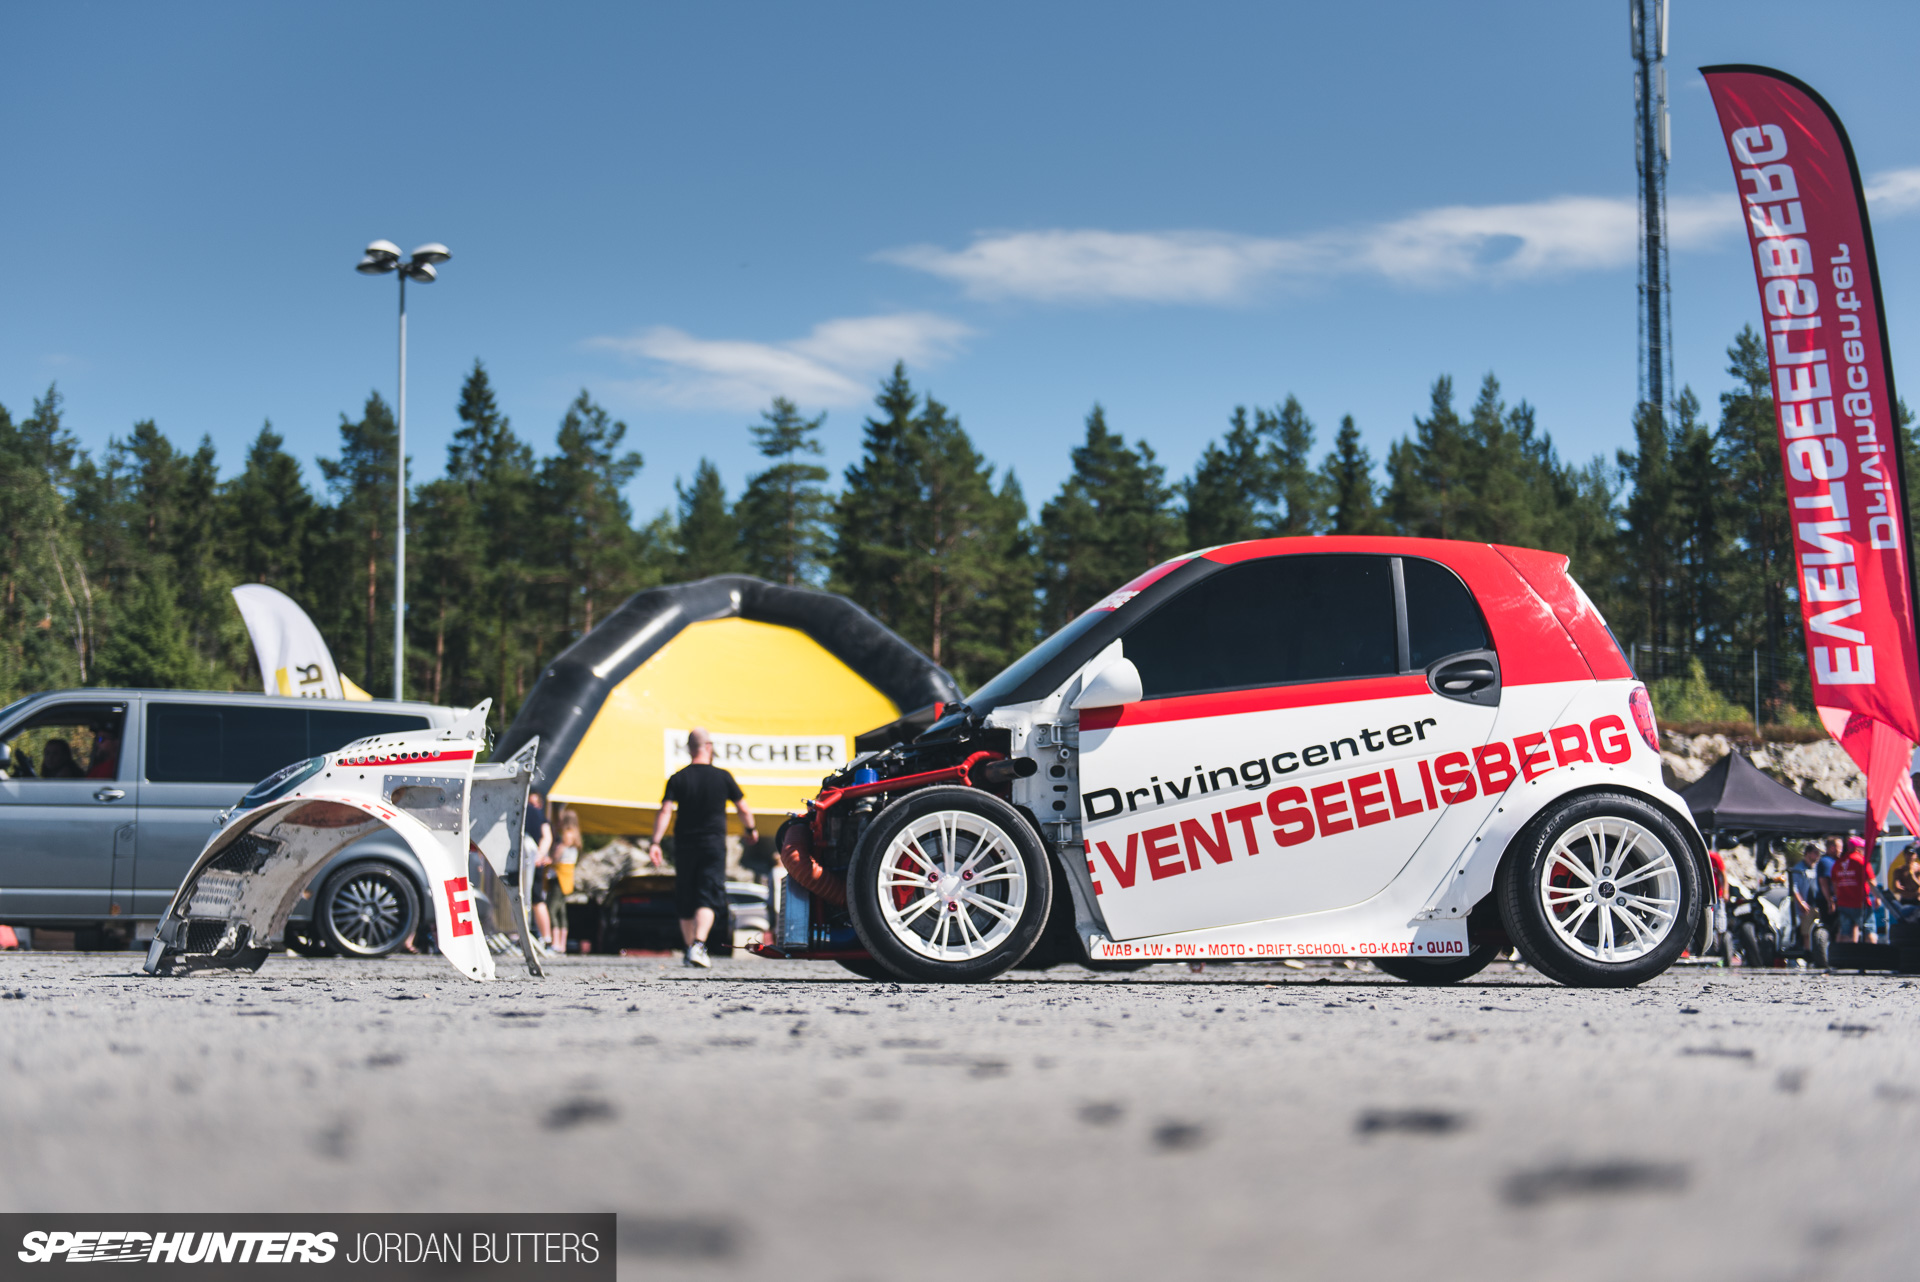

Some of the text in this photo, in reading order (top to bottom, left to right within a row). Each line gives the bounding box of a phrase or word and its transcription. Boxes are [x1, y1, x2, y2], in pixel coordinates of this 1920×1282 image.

[1082, 717, 1437, 822] Drivingcenter
[1083, 714, 1632, 895] VENTSEELISBERG
[1102, 941, 1463, 957] WAB LW PW MOTO DRIFT-SCHOOL GO-KART QUAD
